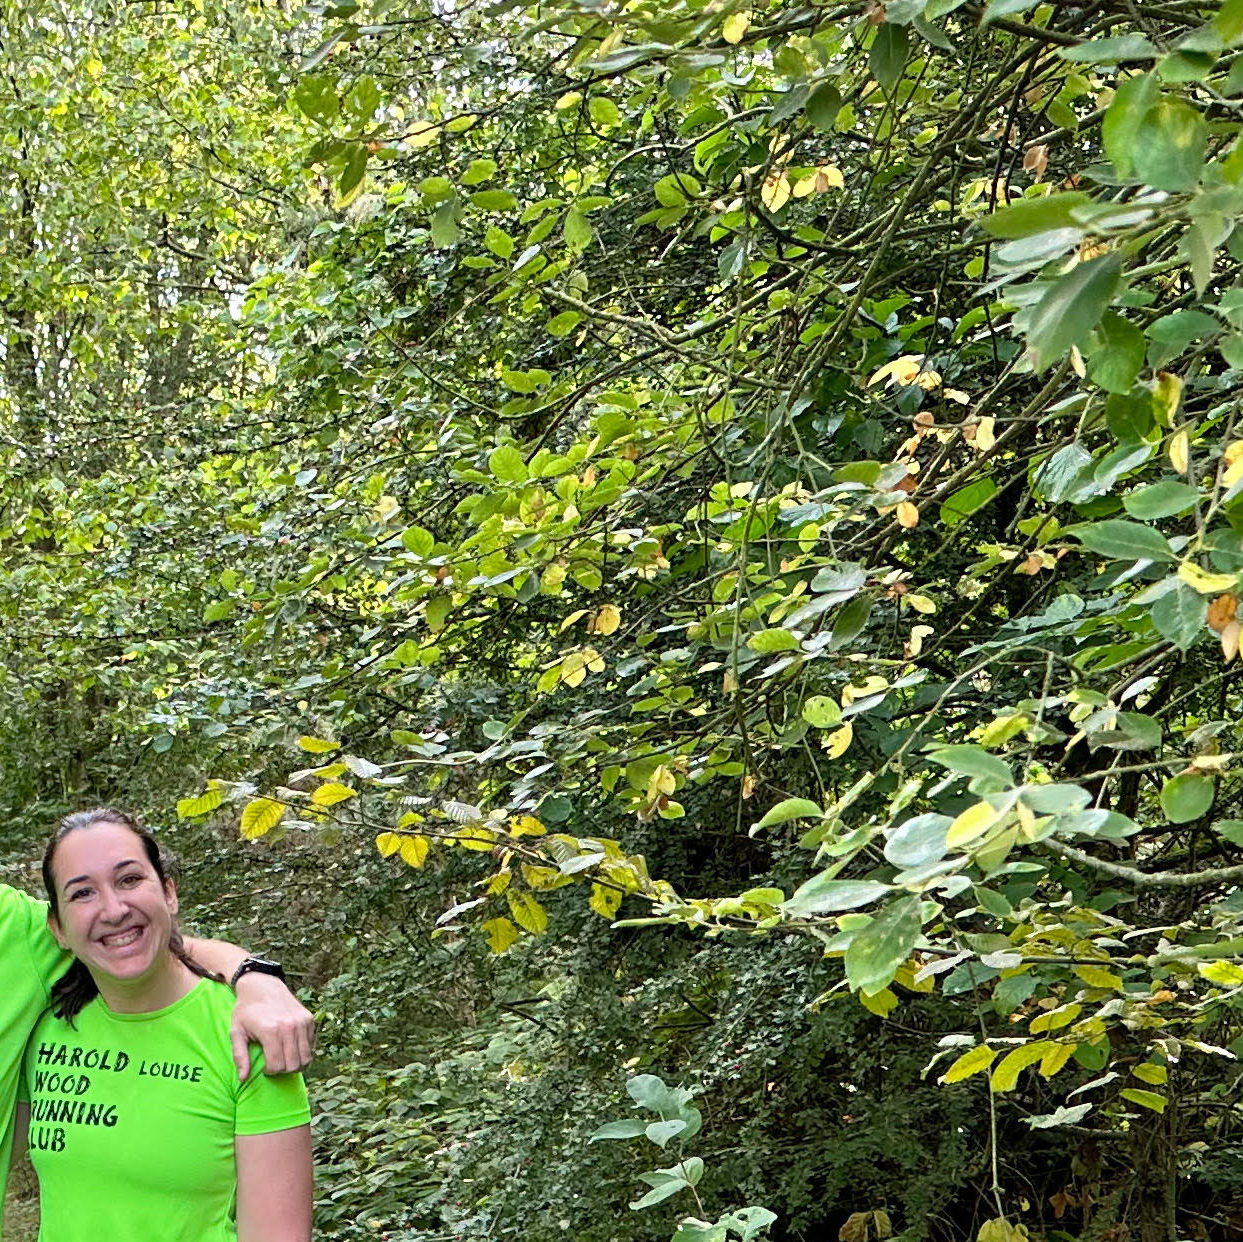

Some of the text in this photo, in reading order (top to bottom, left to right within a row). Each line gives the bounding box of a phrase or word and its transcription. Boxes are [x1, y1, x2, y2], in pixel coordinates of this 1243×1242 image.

[37, 1042, 130, 1073] HAROLD
[33, 1070, 91, 1096] WOOD
[139, 1060, 204, 1082] LOUISE
[30, 1126, 66, 1152] LUB
